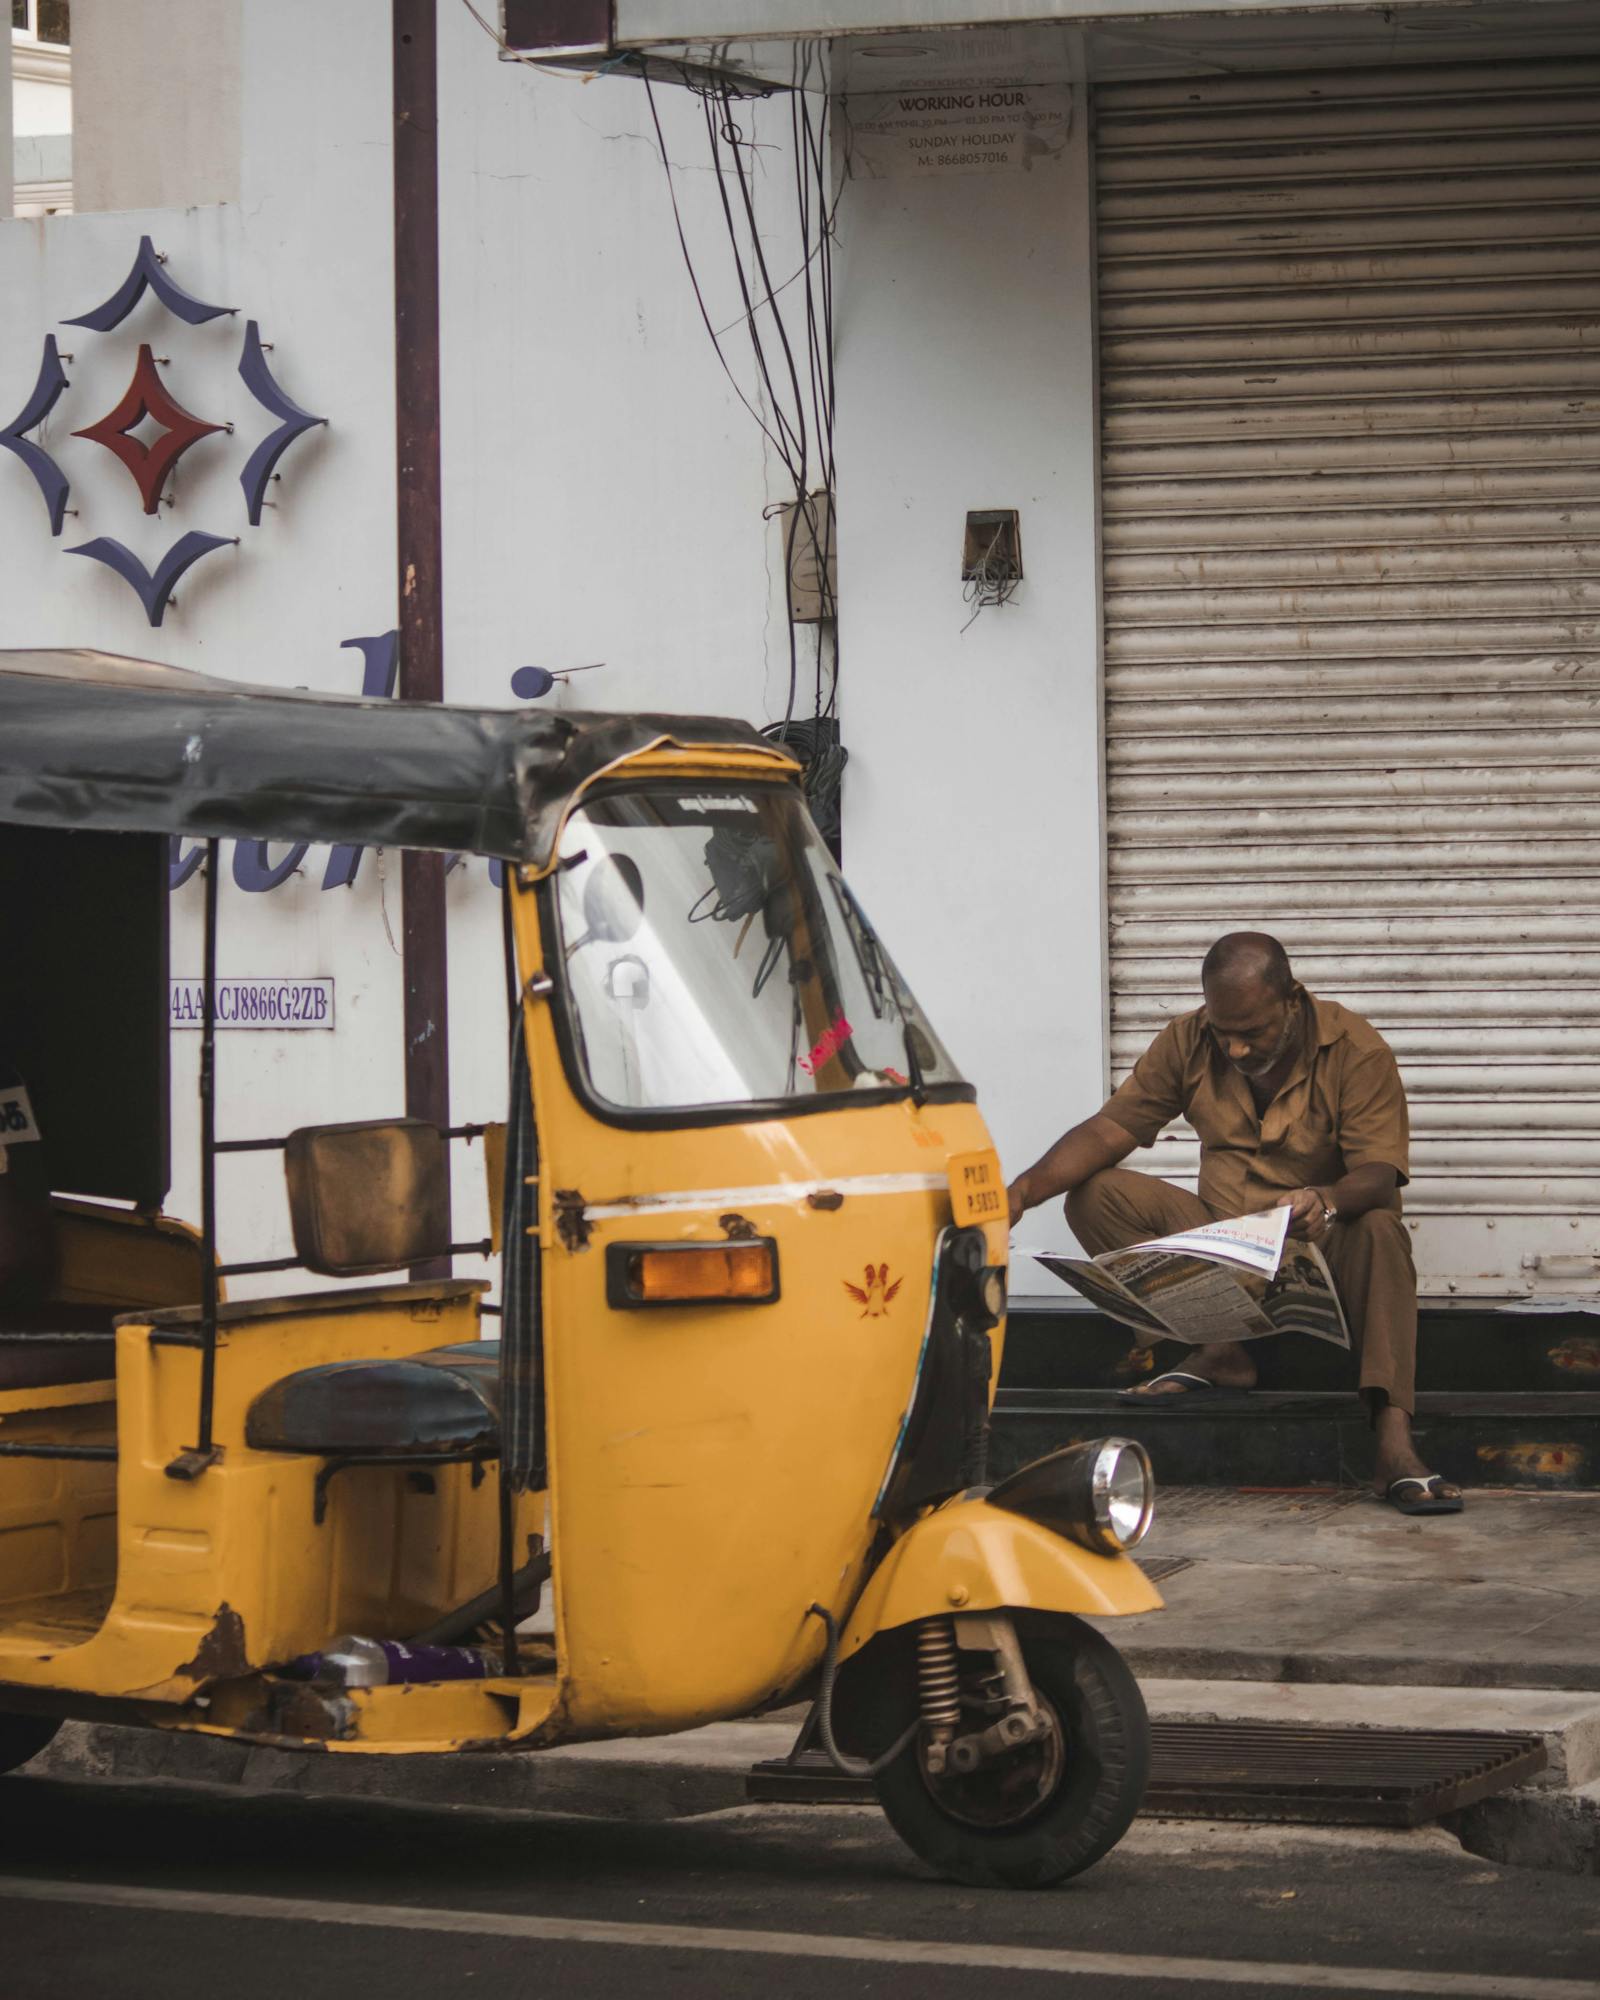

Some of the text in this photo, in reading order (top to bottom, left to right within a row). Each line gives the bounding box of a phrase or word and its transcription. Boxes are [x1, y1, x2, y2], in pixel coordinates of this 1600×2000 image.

[899, 92, 1025, 112] WORKING HOUR
[908, 132, 1017, 149] SUNDAY HOLIDAY
[937, 152, 1009, 166] 8668057016
[172, 986, 327, 1021] 4AACJ8866G2ZB
